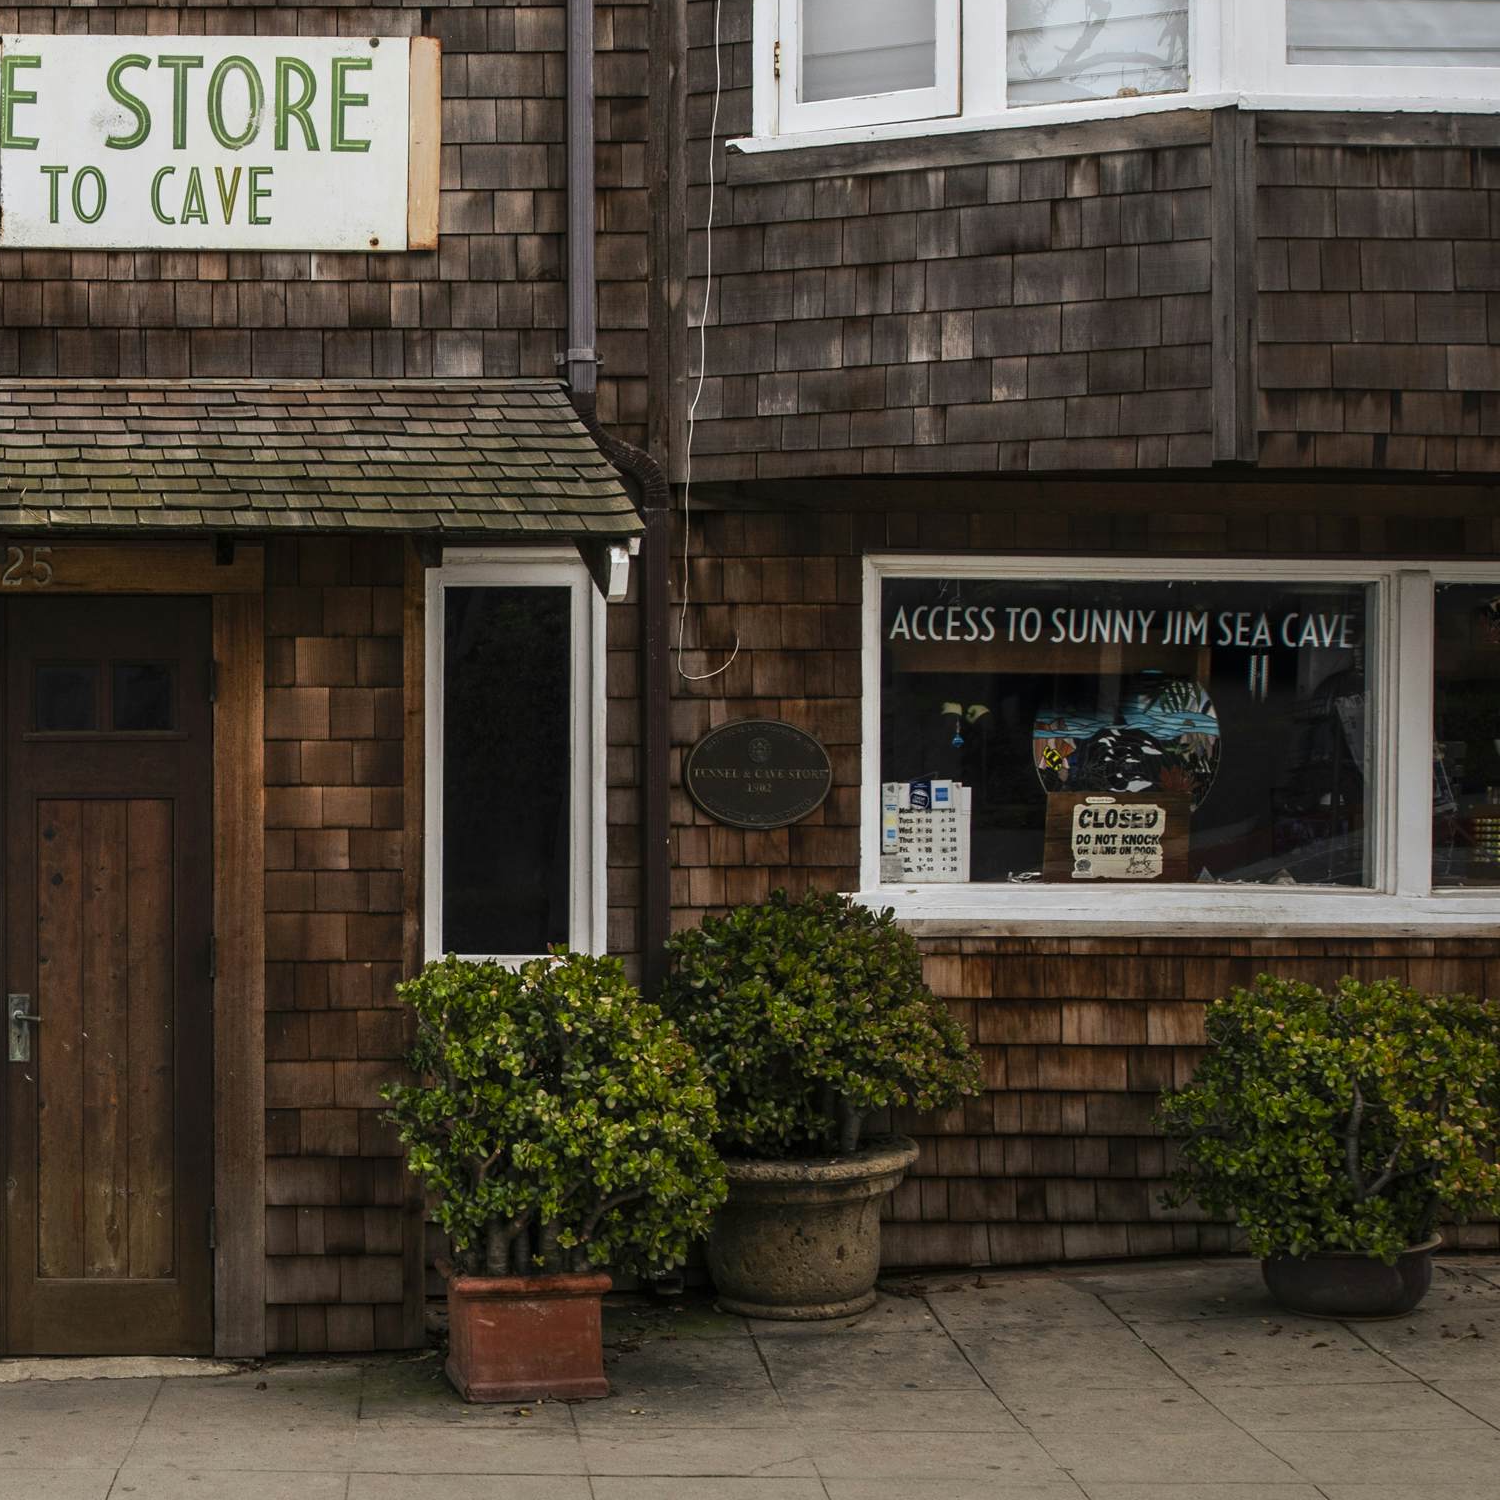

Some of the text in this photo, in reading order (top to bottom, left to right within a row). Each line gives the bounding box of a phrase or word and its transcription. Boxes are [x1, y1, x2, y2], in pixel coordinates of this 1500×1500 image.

[105, 54, 372, 152] STORE
[41, 164, 107, 224] TO
[151, 165, 274, 225] CAVE
[889, 605, 1354, 649] ACCESS TO SUNNY JIM SEA CAVE
[693, 768, 740, 780] TUNNEL
[754, 768, 787, 780] CAVE
[1078, 808, 1159, 829] CLOSED
[1076, 834, 1160, 845] DO NOT KNOCK
[1119, 846, 1132, 855] ON
